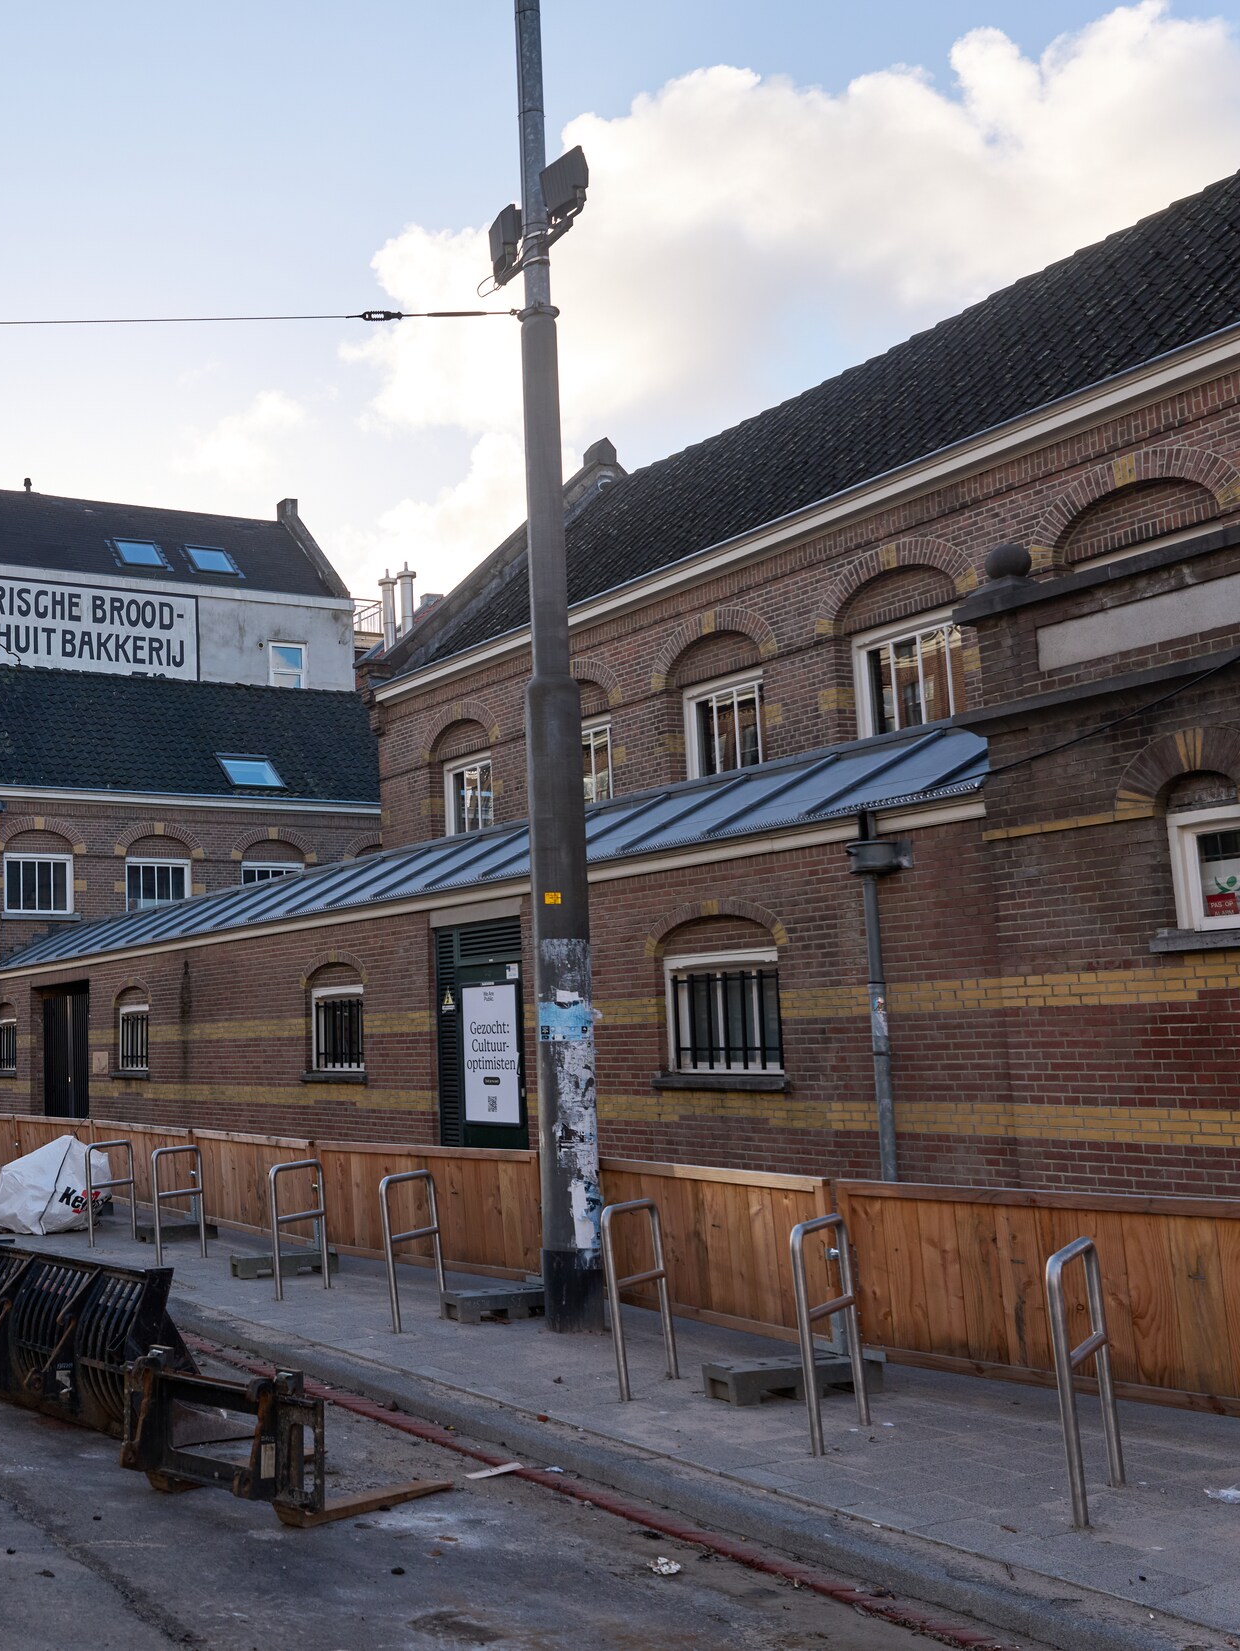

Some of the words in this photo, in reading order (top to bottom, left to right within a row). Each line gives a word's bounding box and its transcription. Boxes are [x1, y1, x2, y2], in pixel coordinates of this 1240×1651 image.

[91, 595, 184, 631] BROOD-
[61, 629, 185, 668] BAKKERIJ
[469, 1020, 510, 1035] Gezocht:
[471, 1038, 510, 1053] Cultuur-
[466, 1056, 516, 1073] optimisten
